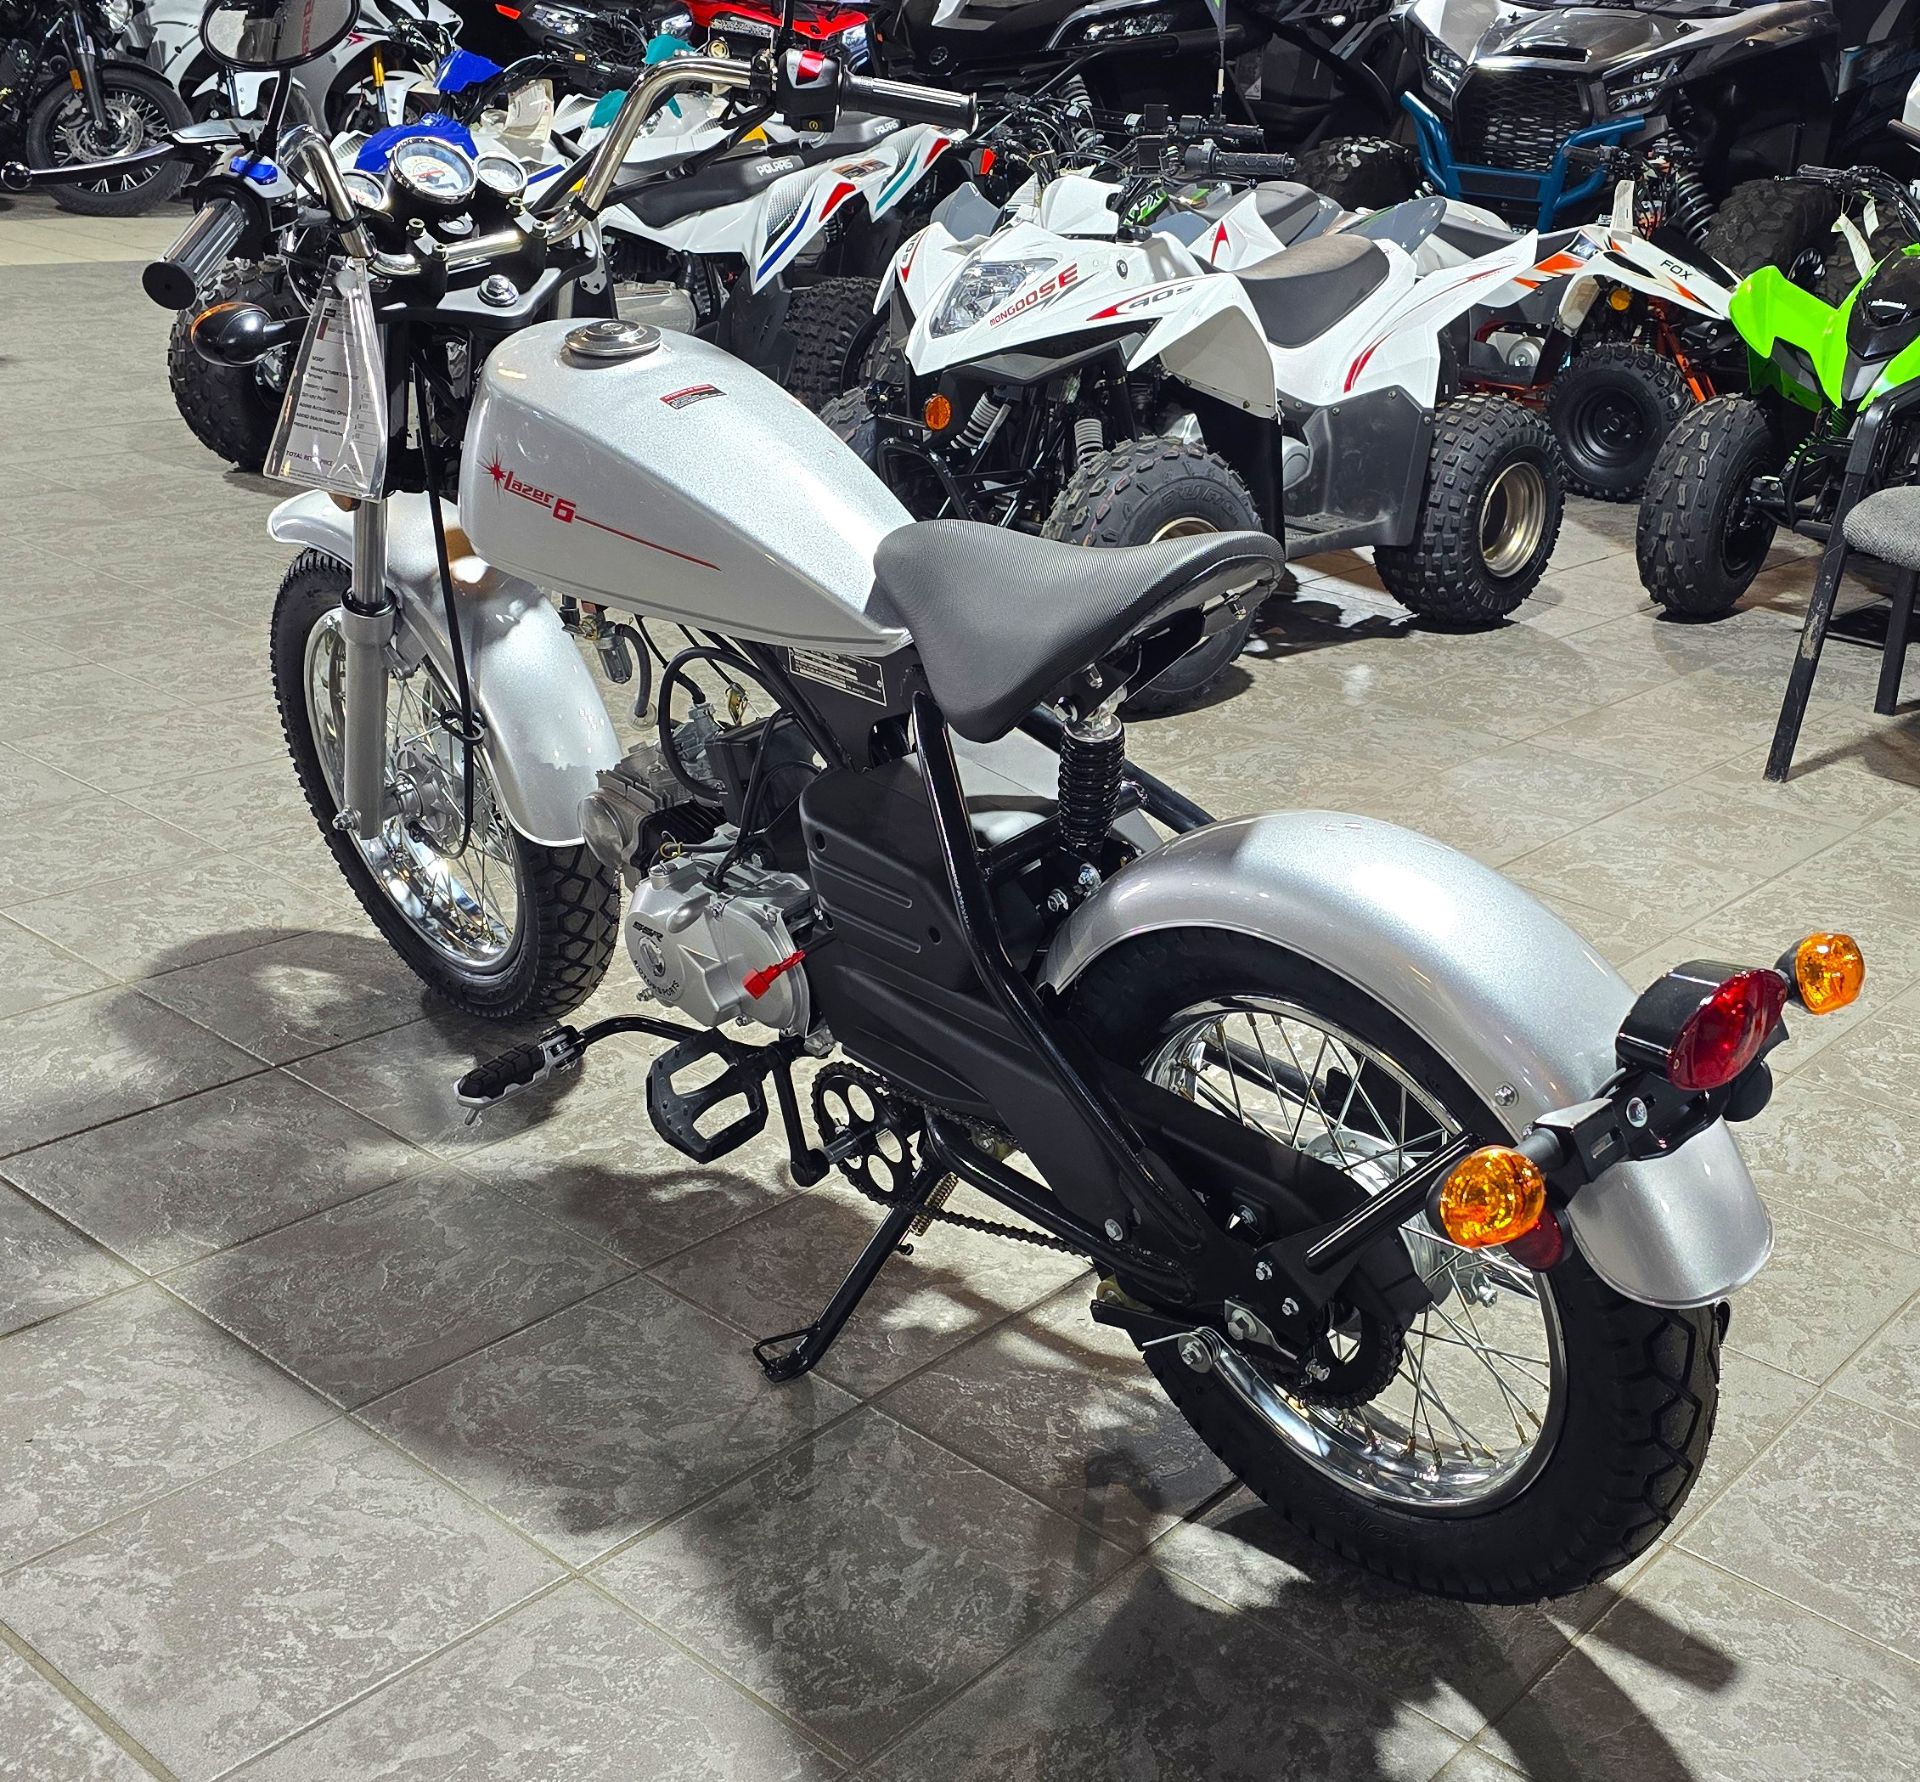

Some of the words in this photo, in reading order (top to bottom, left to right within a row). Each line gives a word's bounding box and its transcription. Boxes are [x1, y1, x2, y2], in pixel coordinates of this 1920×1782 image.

[873, 119, 900, 136] POLARIS
[755, 158, 794, 177] POLARIS
[1660, 259, 1693, 281] FOX
[989, 262, 1079, 328] MONGOOSE
[286, 450, 303, 460] TOTAL
[504, 471, 554, 508] Lazer
[553, 498, 576, 524] 6
[632, 921, 664, 943] SSR
